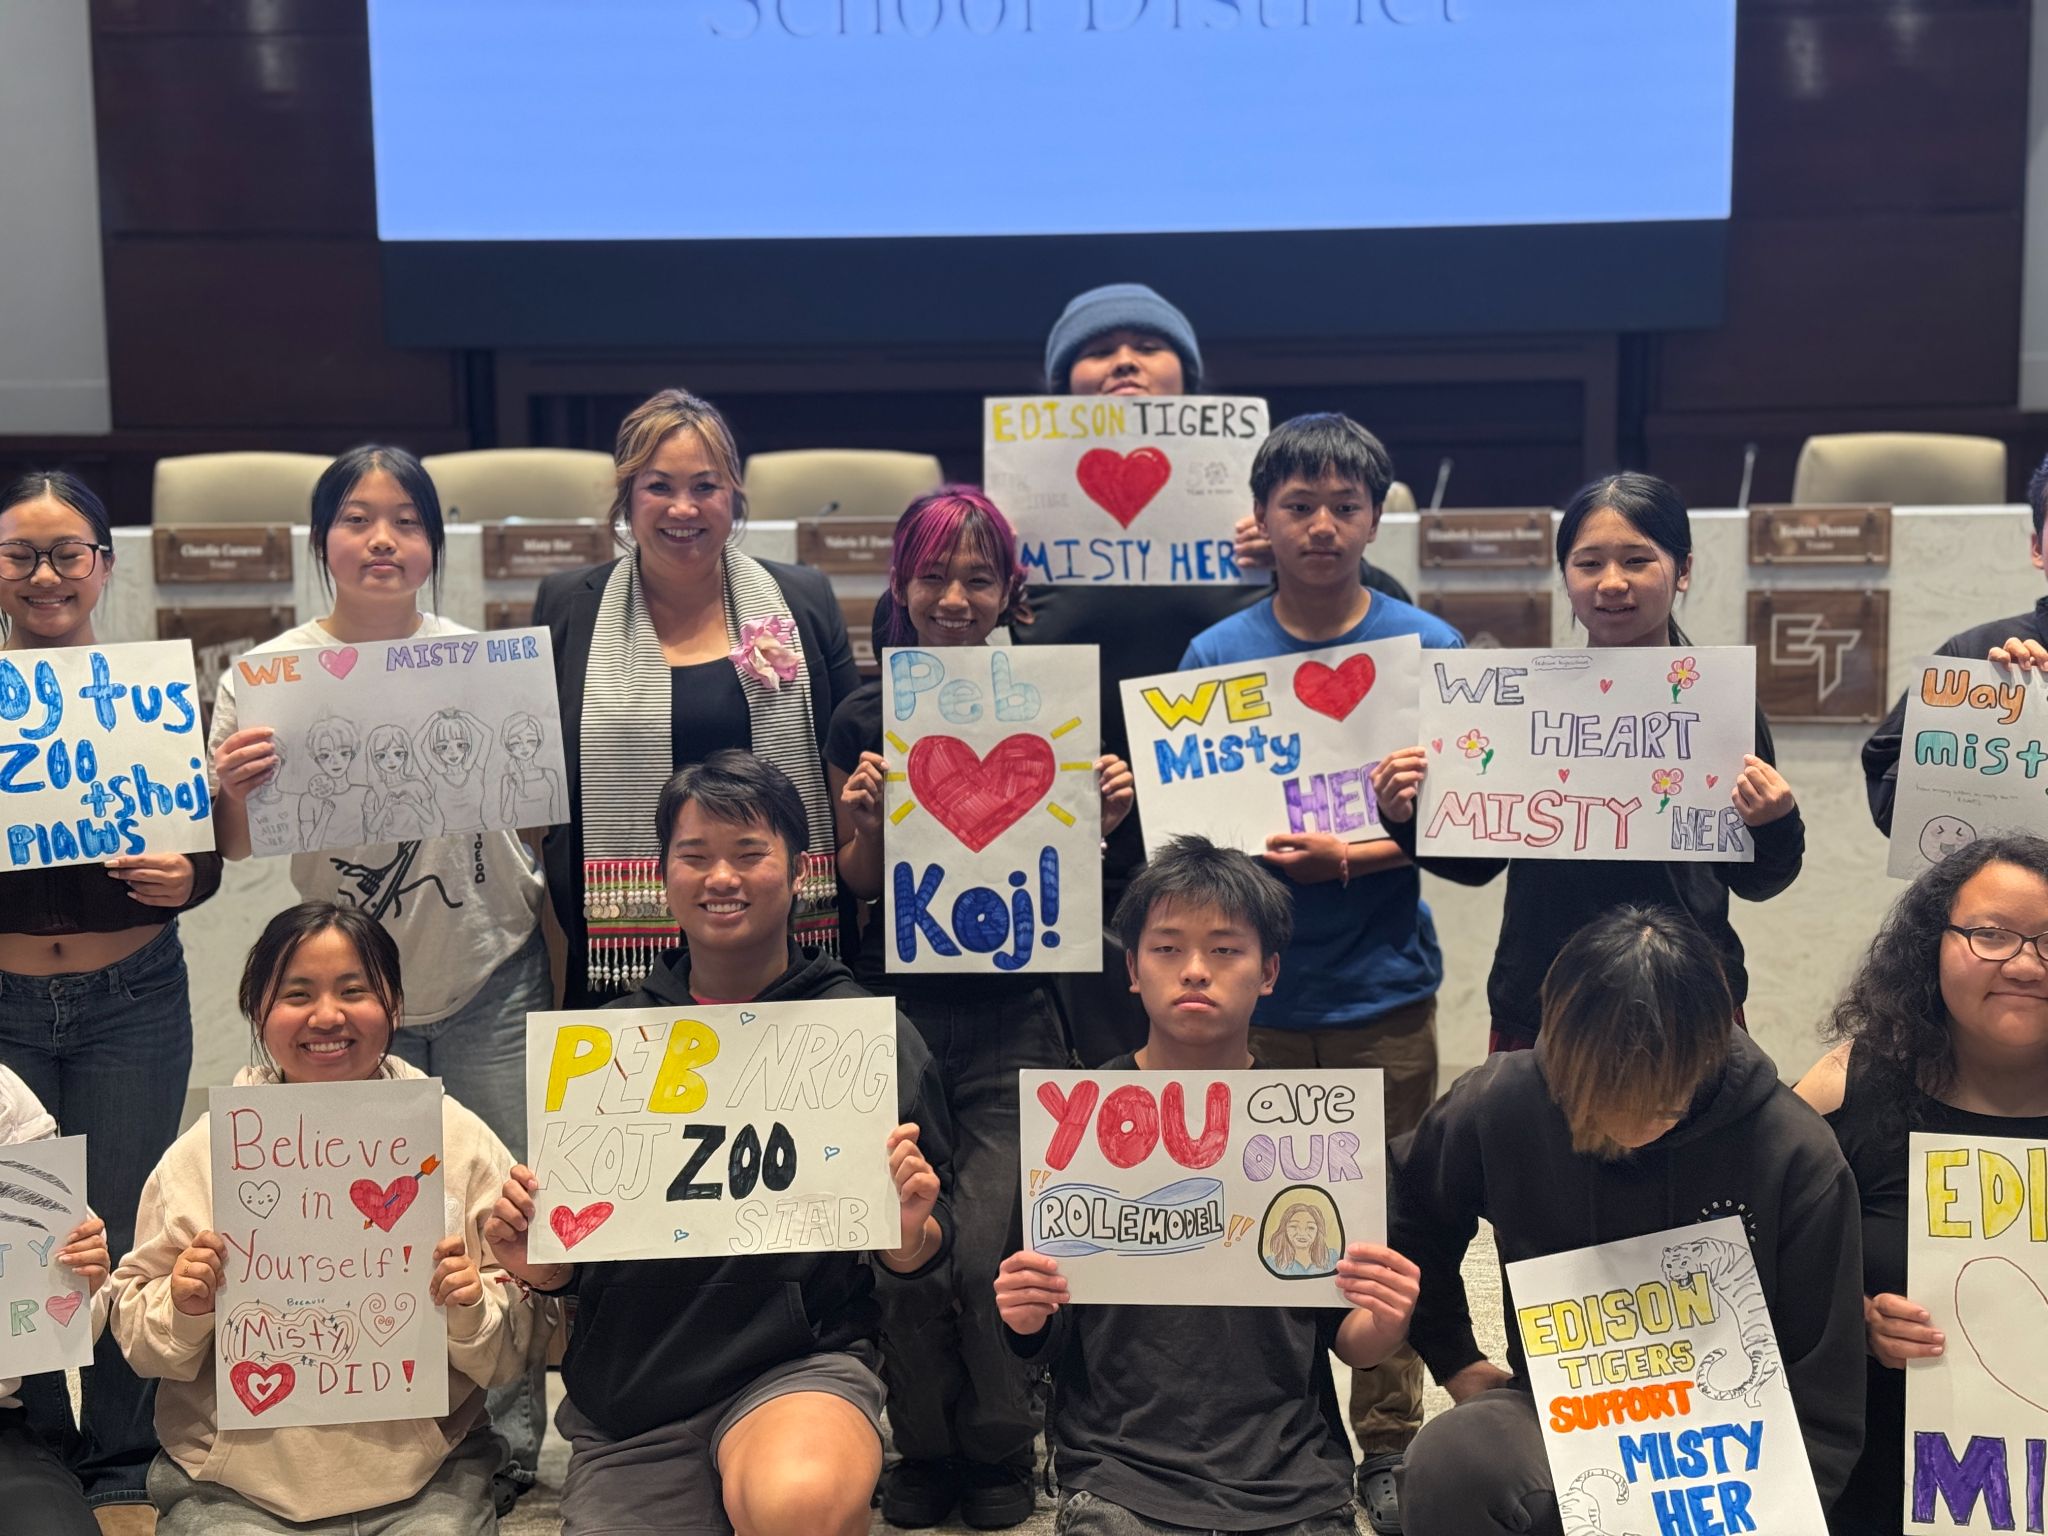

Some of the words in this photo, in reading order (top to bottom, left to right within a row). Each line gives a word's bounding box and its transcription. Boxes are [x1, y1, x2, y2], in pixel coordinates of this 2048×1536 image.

[992, 402, 1126, 441] EDISON
[1133, 402, 1260, 438] TIGERS
[1020, 538, 1151, 582] MISTY
[1170, 540, 1242, 582] HER
[238, 656, 302, 686] WE
[386, 641, 479, 671] MISTY
[486, 636, 539, 663] HER
[890, 650, 1042, 724] Peb
[1434, 662, 1528, 706] WE
[79, 652, 195, 734] tus
[1140, 672, 1273, 731] WE
[1921, 667, 2026, 725] Way
[1153, 725, 1302, 784] Misty
[1531, 710, 1701, 760] HEART
[1424, 789, 1643, 852] MISTY
[1671, 806, 1747, 853] HER
[893, 845, 1061, 970] Koj!
[544, 1019, 720, 1115] PEB
[725, 1023, 896, 1113] NROG
[226, 1108, 410, 1171] Believe
[1036, 1080, 1232, 1171] YOU
[1247, 1083, 1356, 1125] are
[535, 1121, 671, 1200] KOJ
[666, 1121, 798, 1201] ZOO
[1242, 1131, 1363, 1182] OUR
[302, 1186, 334, 1220] in
[1924, 1148, 2048, 1243] EDI
[728, 1197, 871, 1255] SIAB
[222, 1228, 413, 1284] Yourself!
[10, 1299, 40, 1337] R
[241, 1315, 345, 1358] Misty
[1518, 1271, 1716, 1357] EDISON
[319, 1360, 416, 1395] DID!
[1558, 1340, 1696, 1389] TIGERS
[1549, 1380, 1696, 1433] SUPPORT
[1617, 1420, 1764, 1484] MISTY
[1650, 1480, 1758, 1536] HER
[1911, 1430, 2047, 1534] MI
